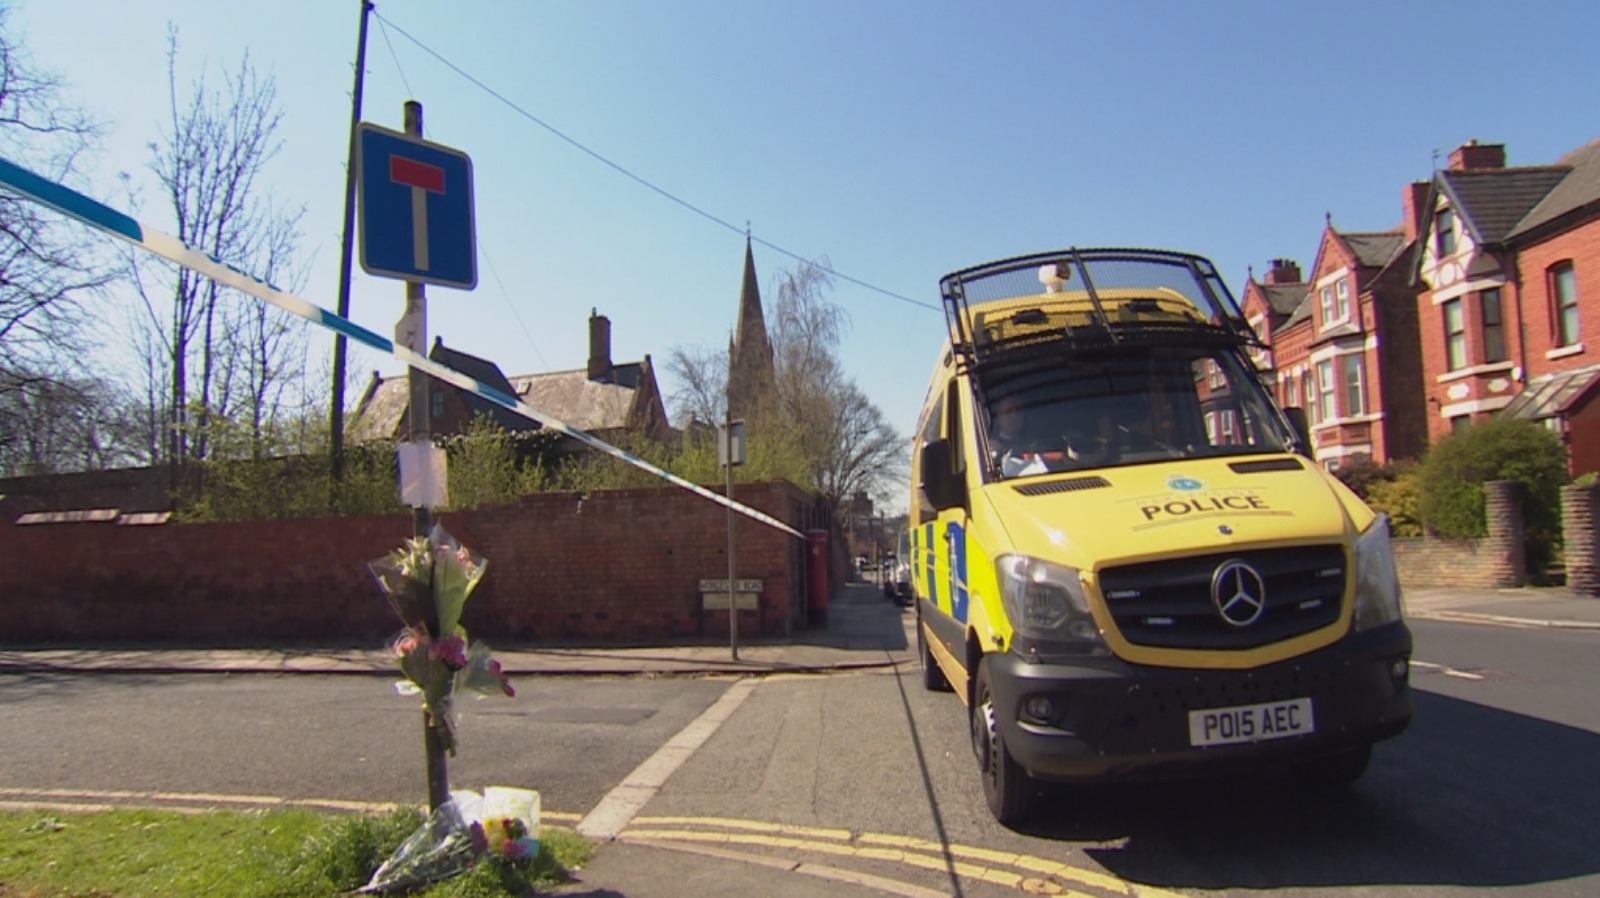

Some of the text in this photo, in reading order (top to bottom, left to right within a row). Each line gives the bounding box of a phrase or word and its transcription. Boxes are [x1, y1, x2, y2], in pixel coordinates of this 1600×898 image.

[1141, 495, 1270, 520] POLICE
[1204, 703, 1301, 740] PO15 AEC
